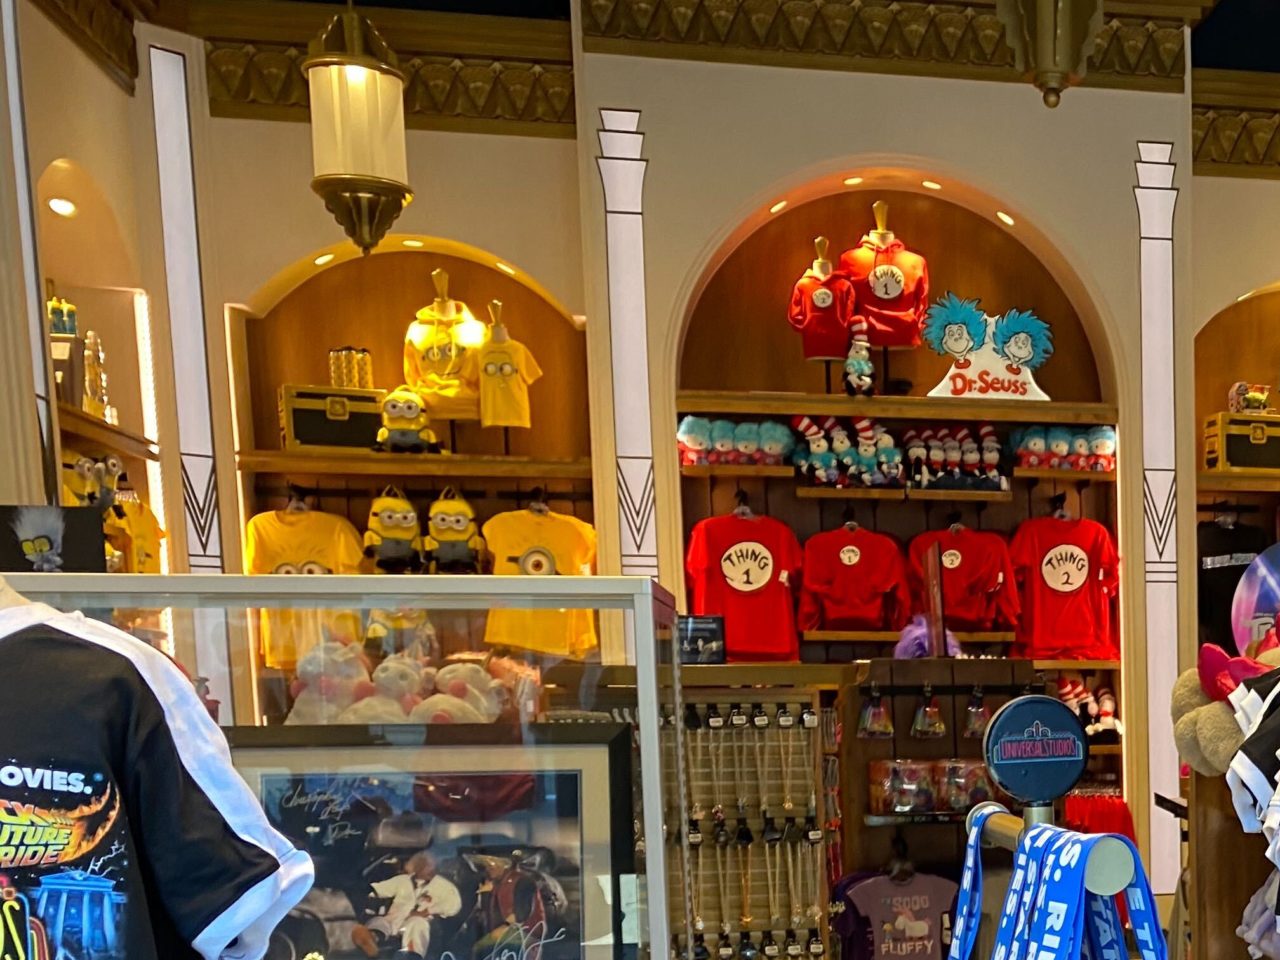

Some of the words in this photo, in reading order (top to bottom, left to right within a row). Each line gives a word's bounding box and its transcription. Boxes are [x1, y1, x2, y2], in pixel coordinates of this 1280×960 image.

[723, 548, 769, 570] THING
[1045, 551, 1086, 571] THING
[742, 568, 753, 585] 1
[1061, 571, 1073, 585] 2
[0, 765, 92, 794] OVIES.
[881, 940, 934, 955] FLUFFY
